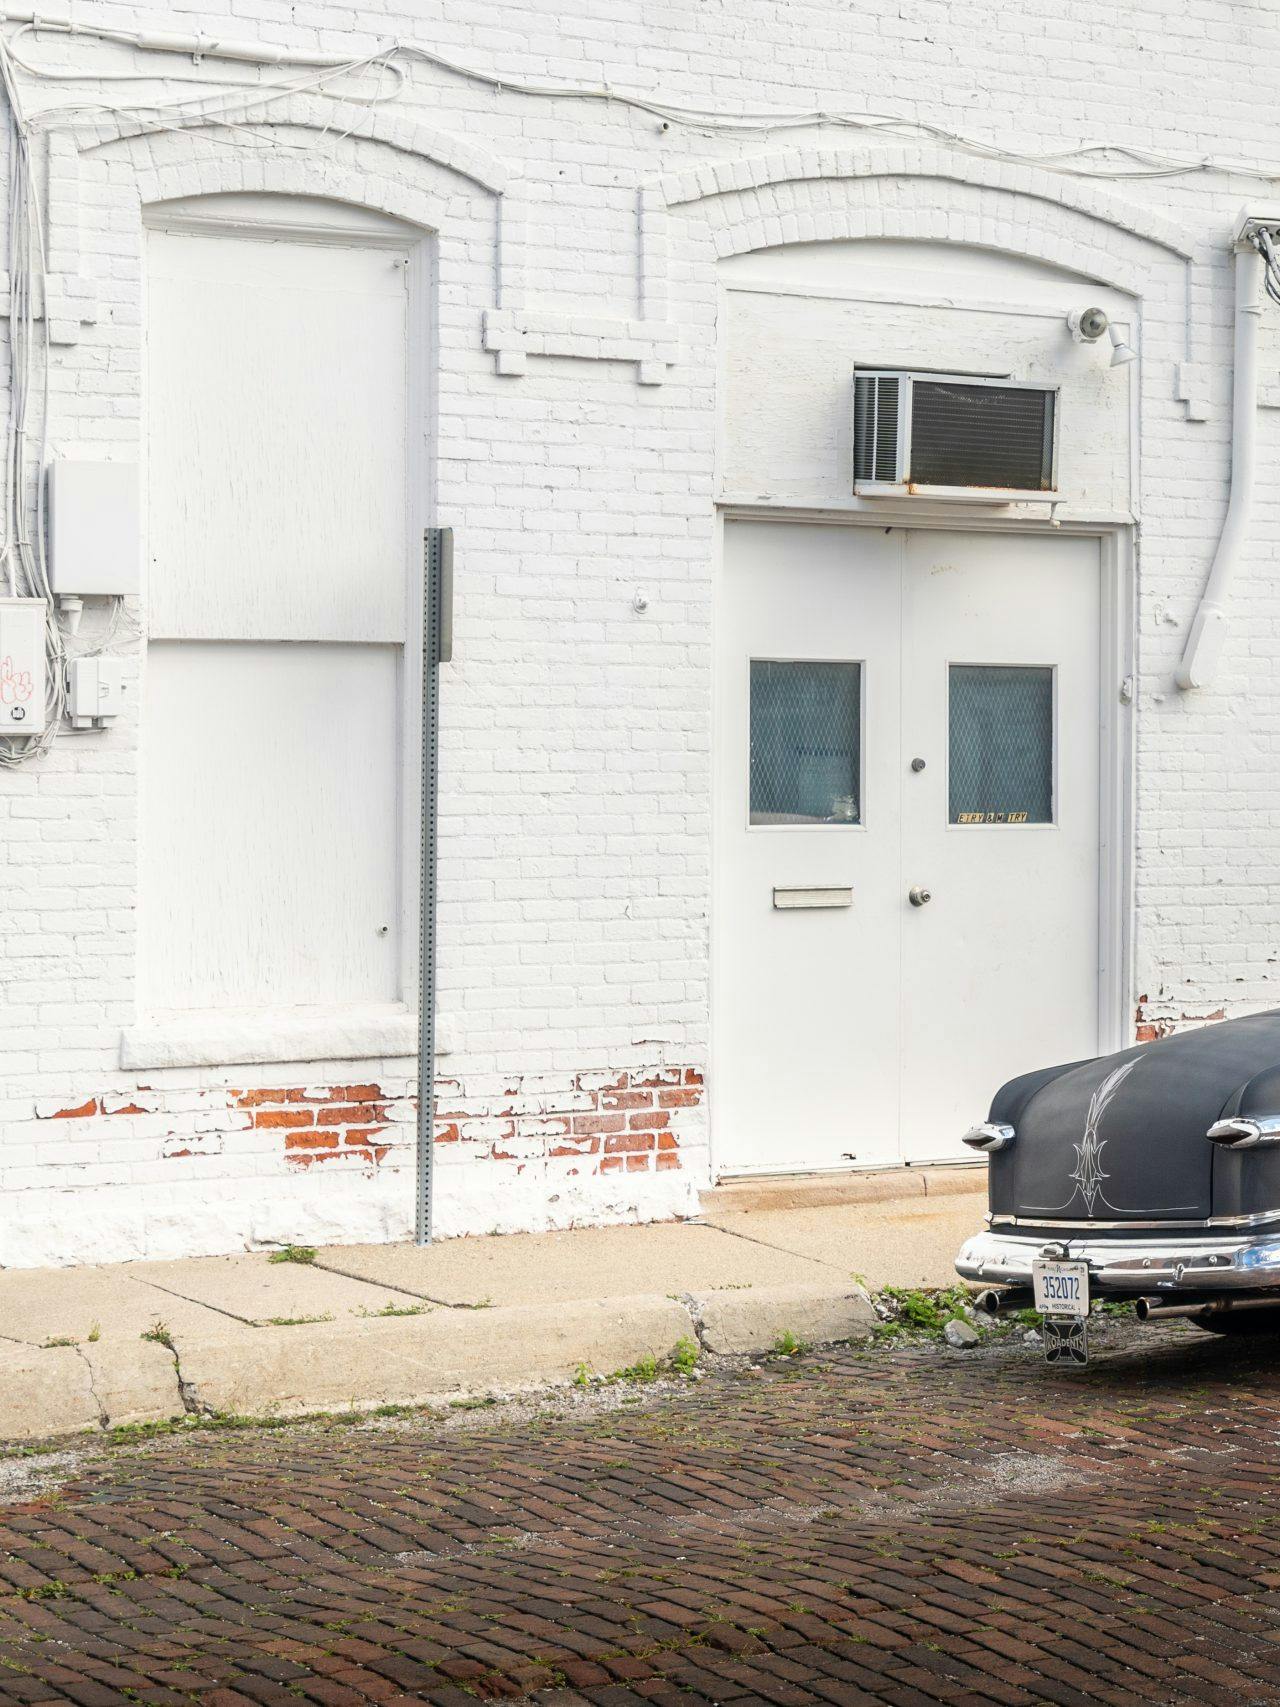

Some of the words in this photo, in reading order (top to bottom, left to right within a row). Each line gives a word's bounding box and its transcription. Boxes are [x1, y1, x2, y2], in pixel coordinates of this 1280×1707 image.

[1009, 812, 1027, 822] TRY
[1042, 1276, 1080, 1300] 352072
[1052, 1303, 1076, 1311] HISTORICAL
